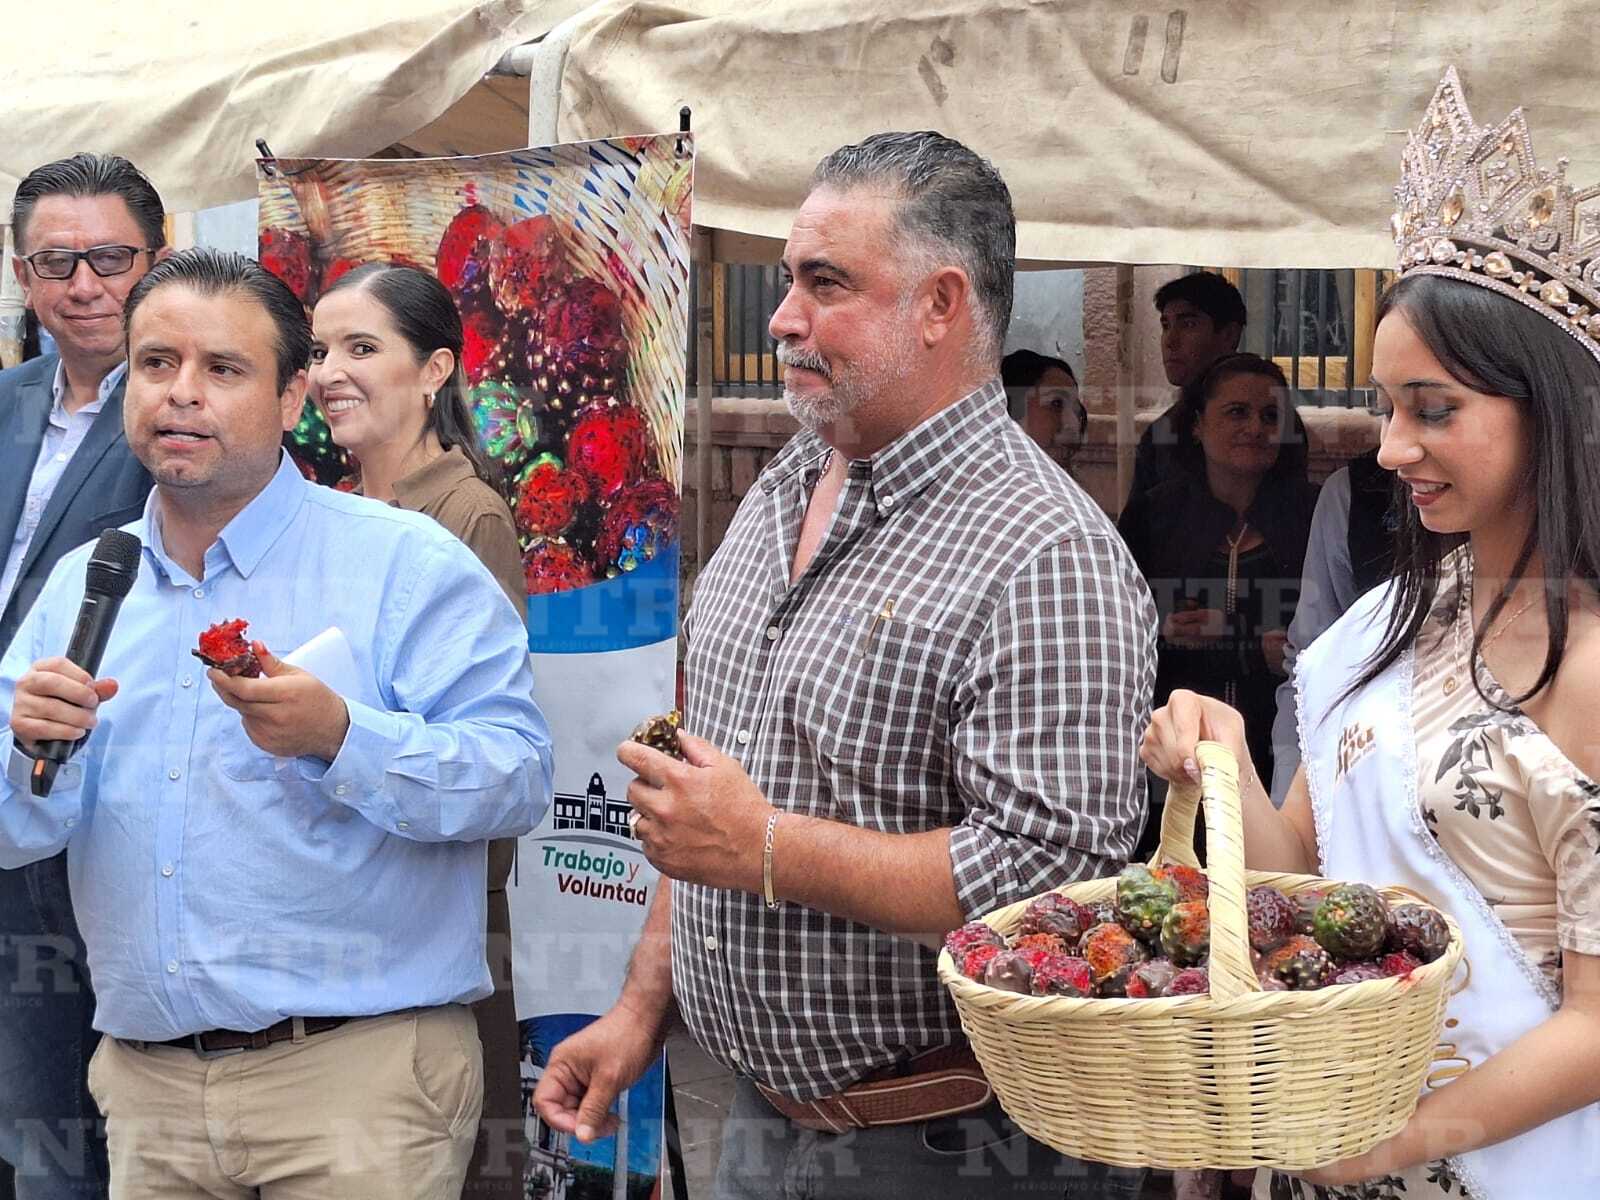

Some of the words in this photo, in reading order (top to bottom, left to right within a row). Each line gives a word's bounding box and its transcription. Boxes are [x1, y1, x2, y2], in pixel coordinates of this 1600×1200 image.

[542, 846, 625, 879] Trabajo
[626, 862, 639, 883] y
[557, 873, 648, 906] Voluntad
